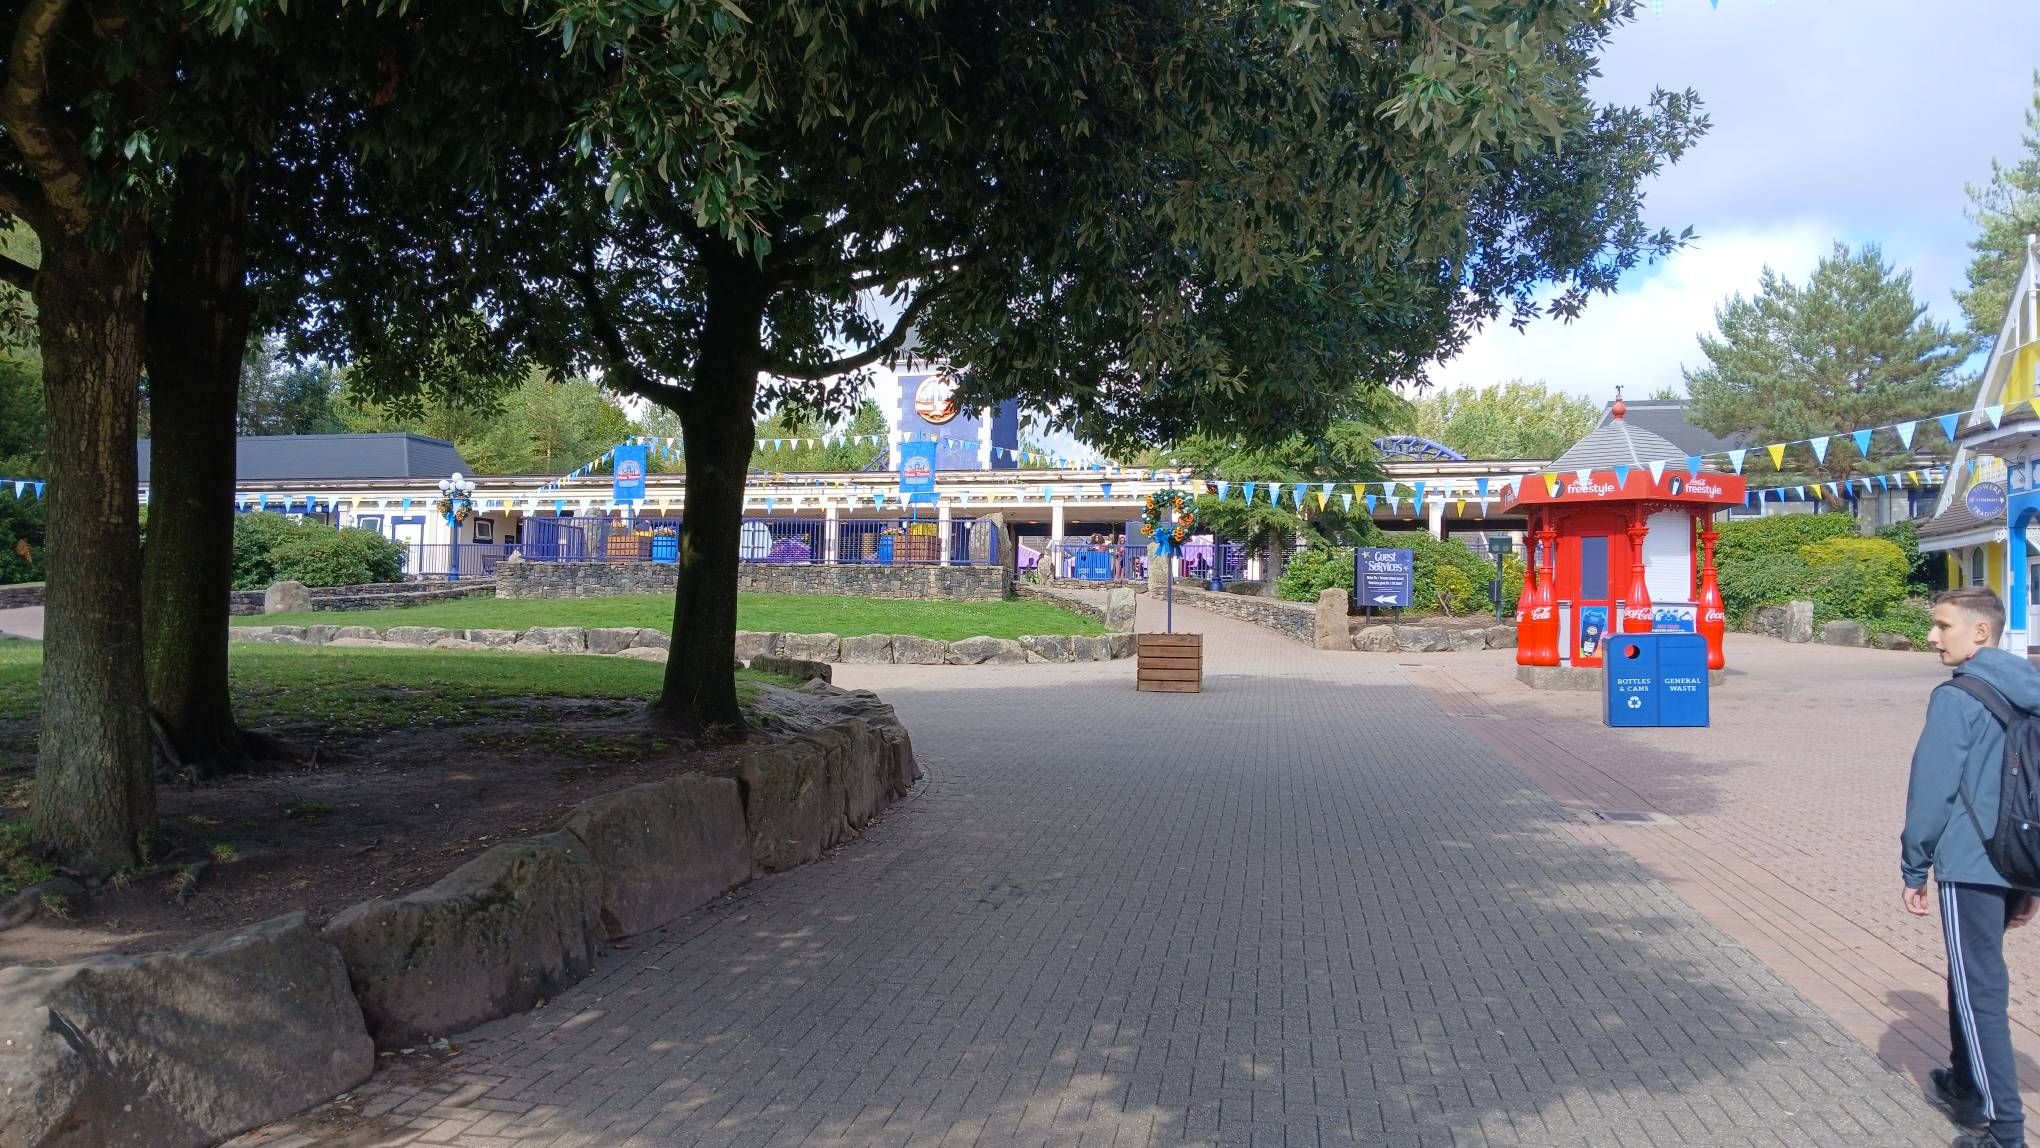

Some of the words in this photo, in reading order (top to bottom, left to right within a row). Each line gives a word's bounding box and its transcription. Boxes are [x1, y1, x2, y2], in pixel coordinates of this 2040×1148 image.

[1567, 482, 1616, 496] freestyle
[1685, 482, 1722, 498] freestyle
[1374, 551, 1397, 562] Guest
[1368, 560, 1403, 573] Services
